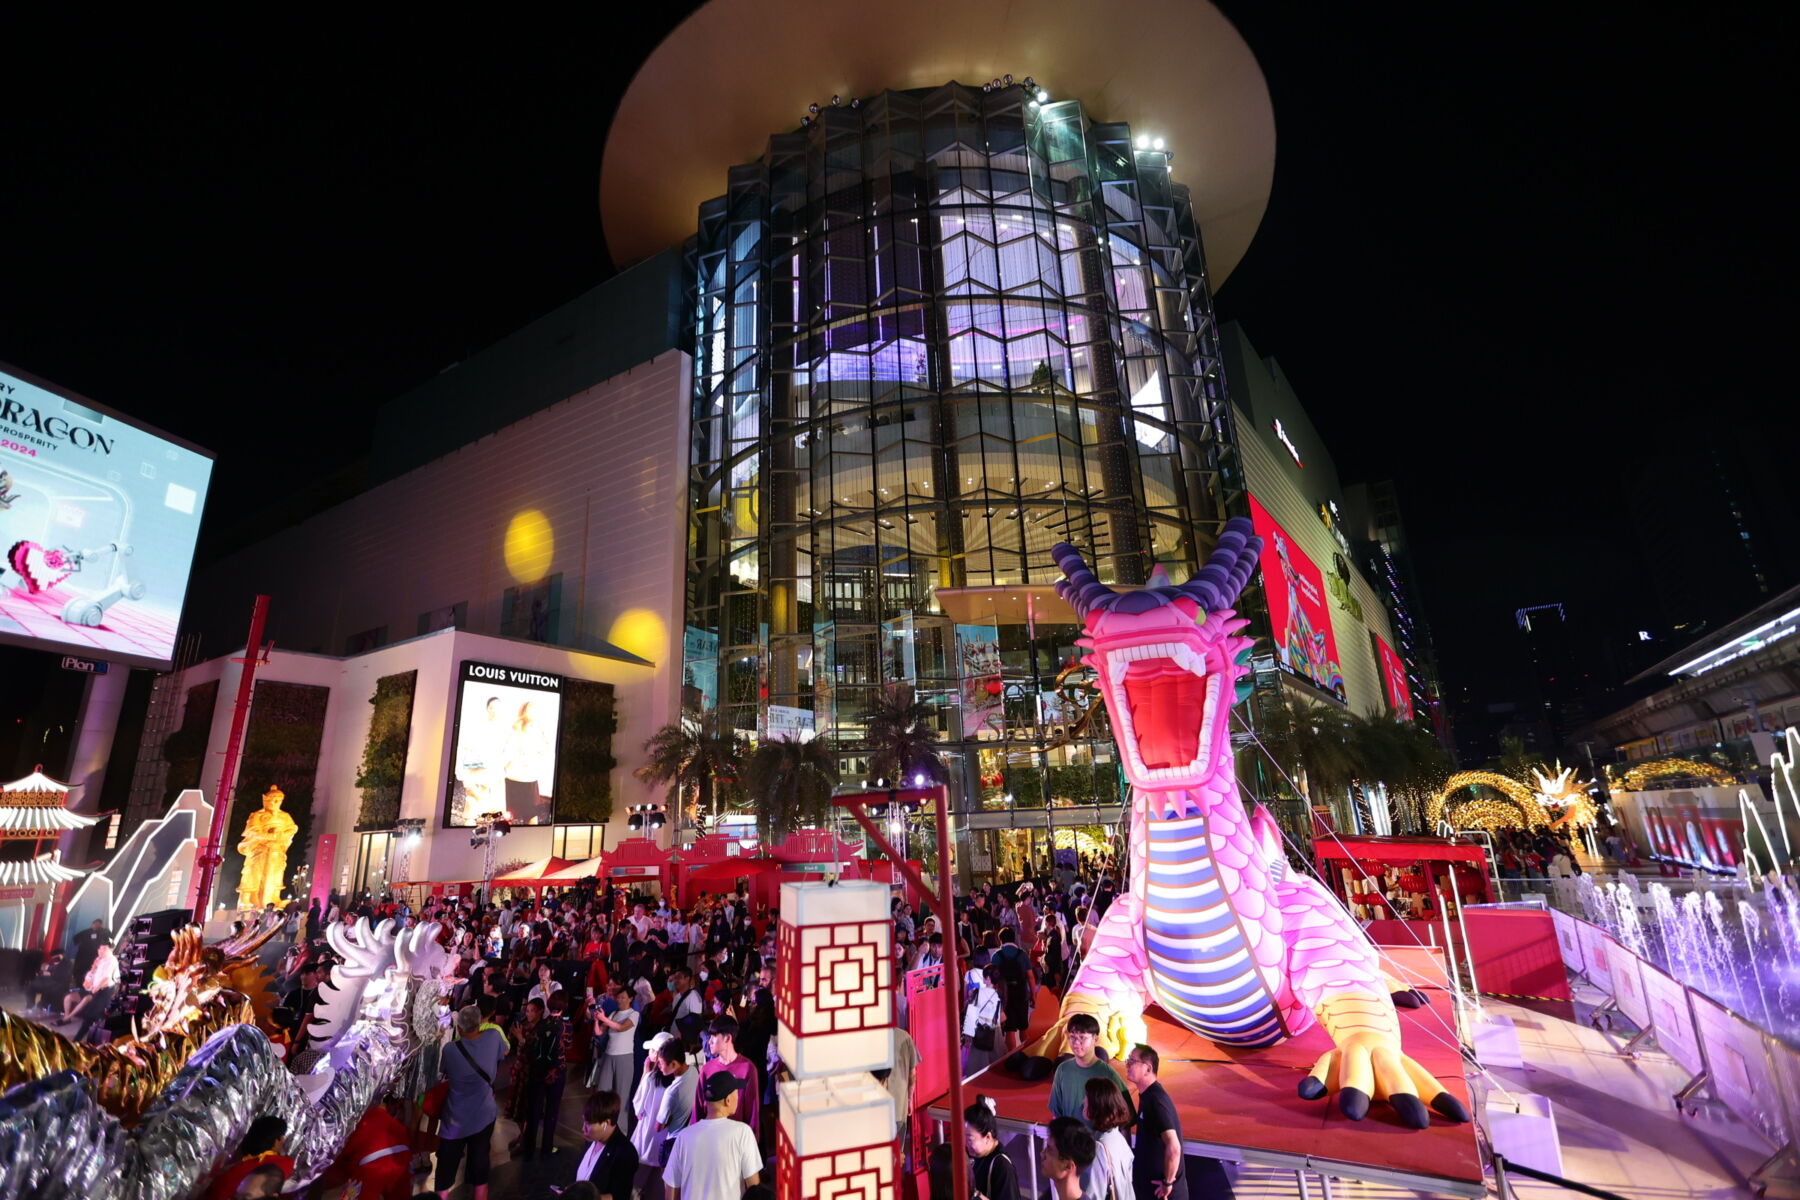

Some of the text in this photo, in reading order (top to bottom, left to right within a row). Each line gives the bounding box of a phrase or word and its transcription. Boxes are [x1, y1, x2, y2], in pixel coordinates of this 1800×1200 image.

[0, 398, 114, 455] RAGON
[1, 439, 37, 457] 2024
[469, 665, 559, 688] LOUIS VUITTON
[984, 711, 1058, 741] SIAM
